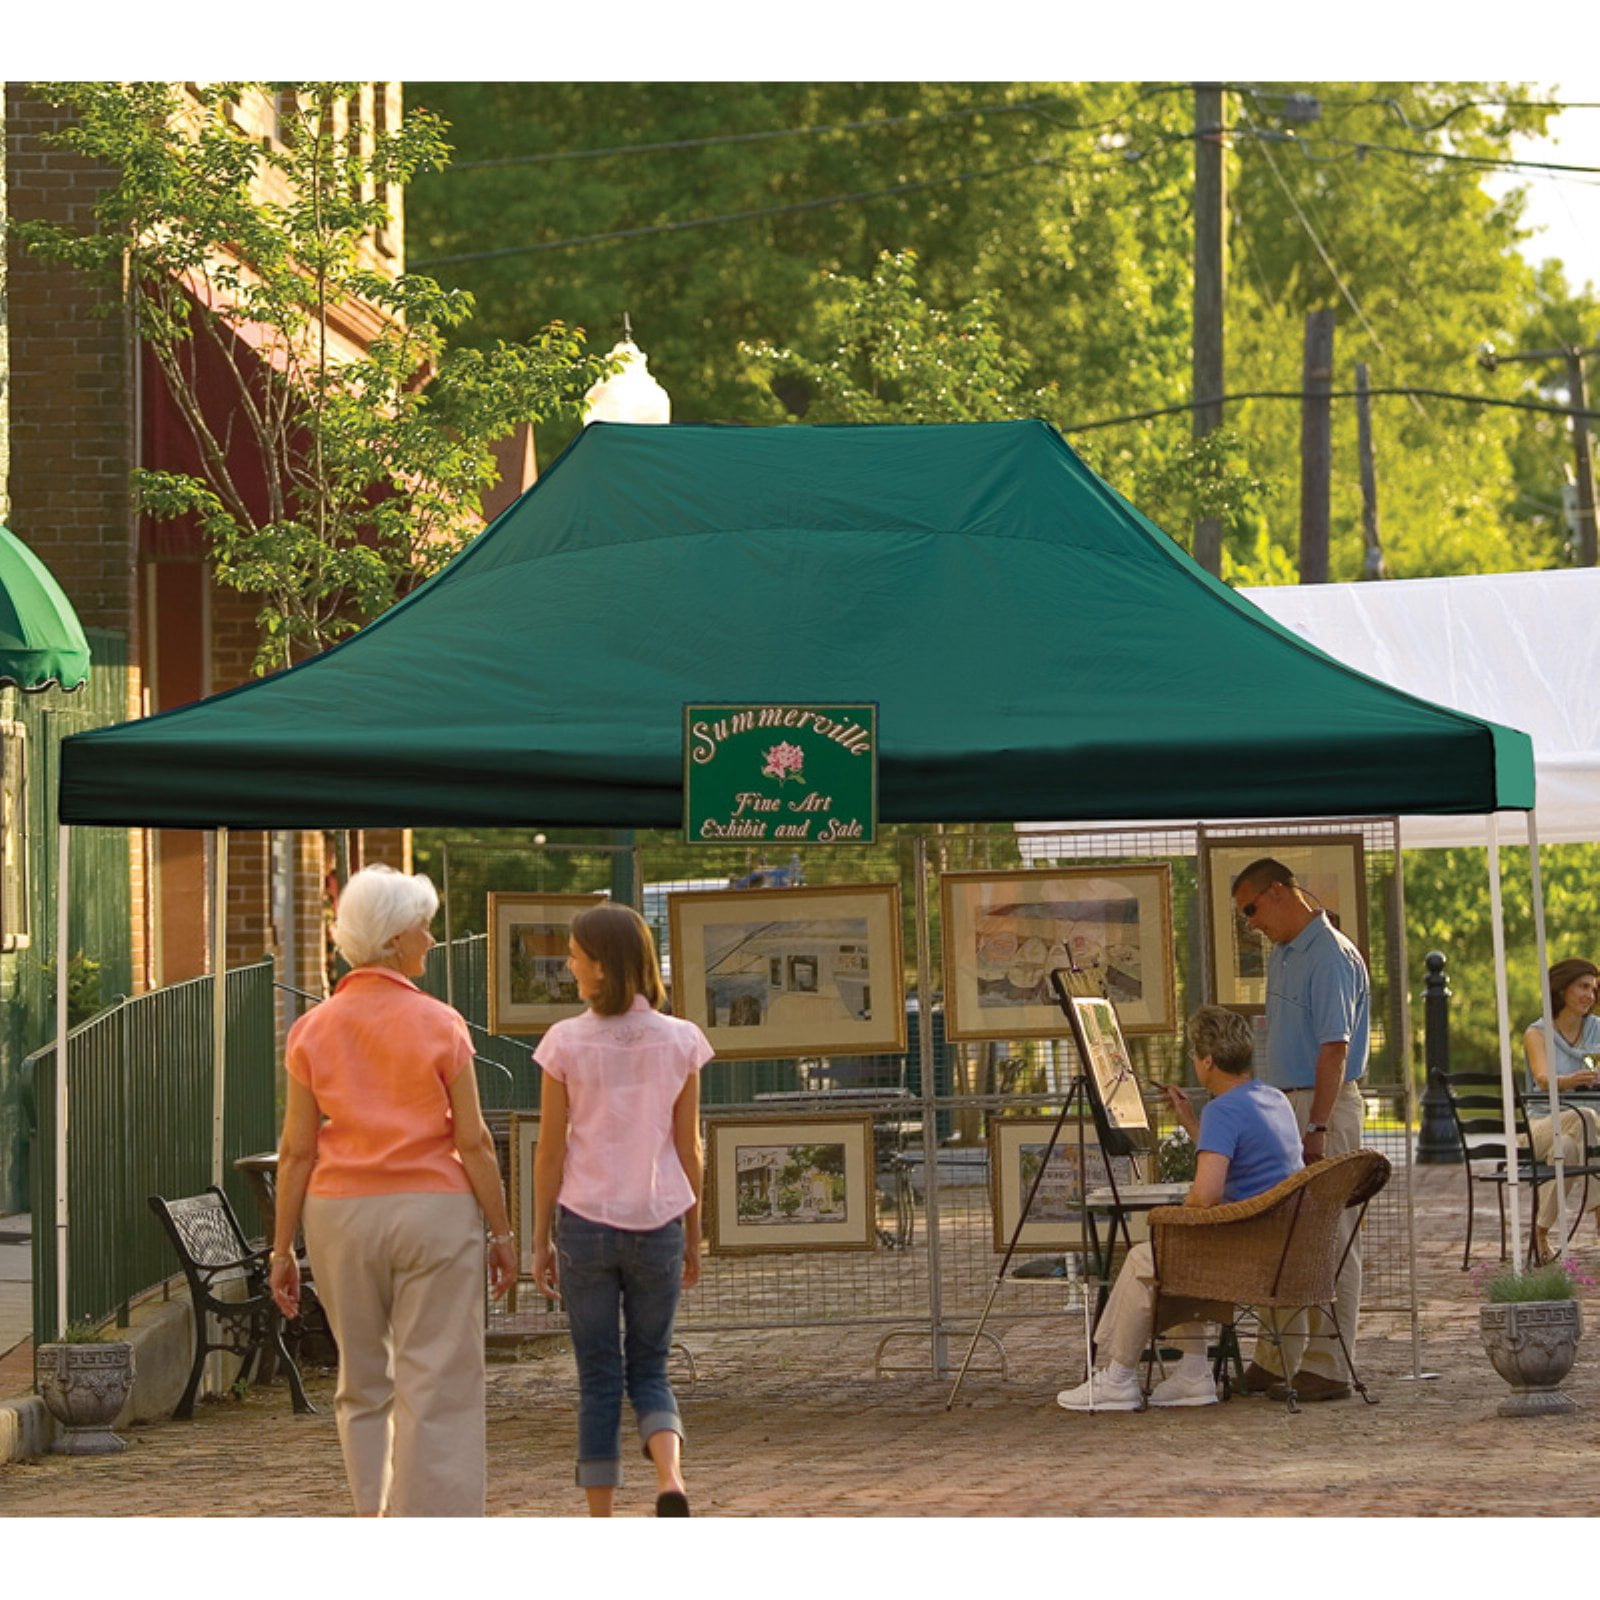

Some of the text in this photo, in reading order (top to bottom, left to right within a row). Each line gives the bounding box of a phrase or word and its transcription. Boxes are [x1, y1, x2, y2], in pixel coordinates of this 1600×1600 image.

[692, 708, 871, 764] Summerville
[731, 791, 833, 817] Fine Art
[700, 818, 863, 843] Exhibit and Sale
